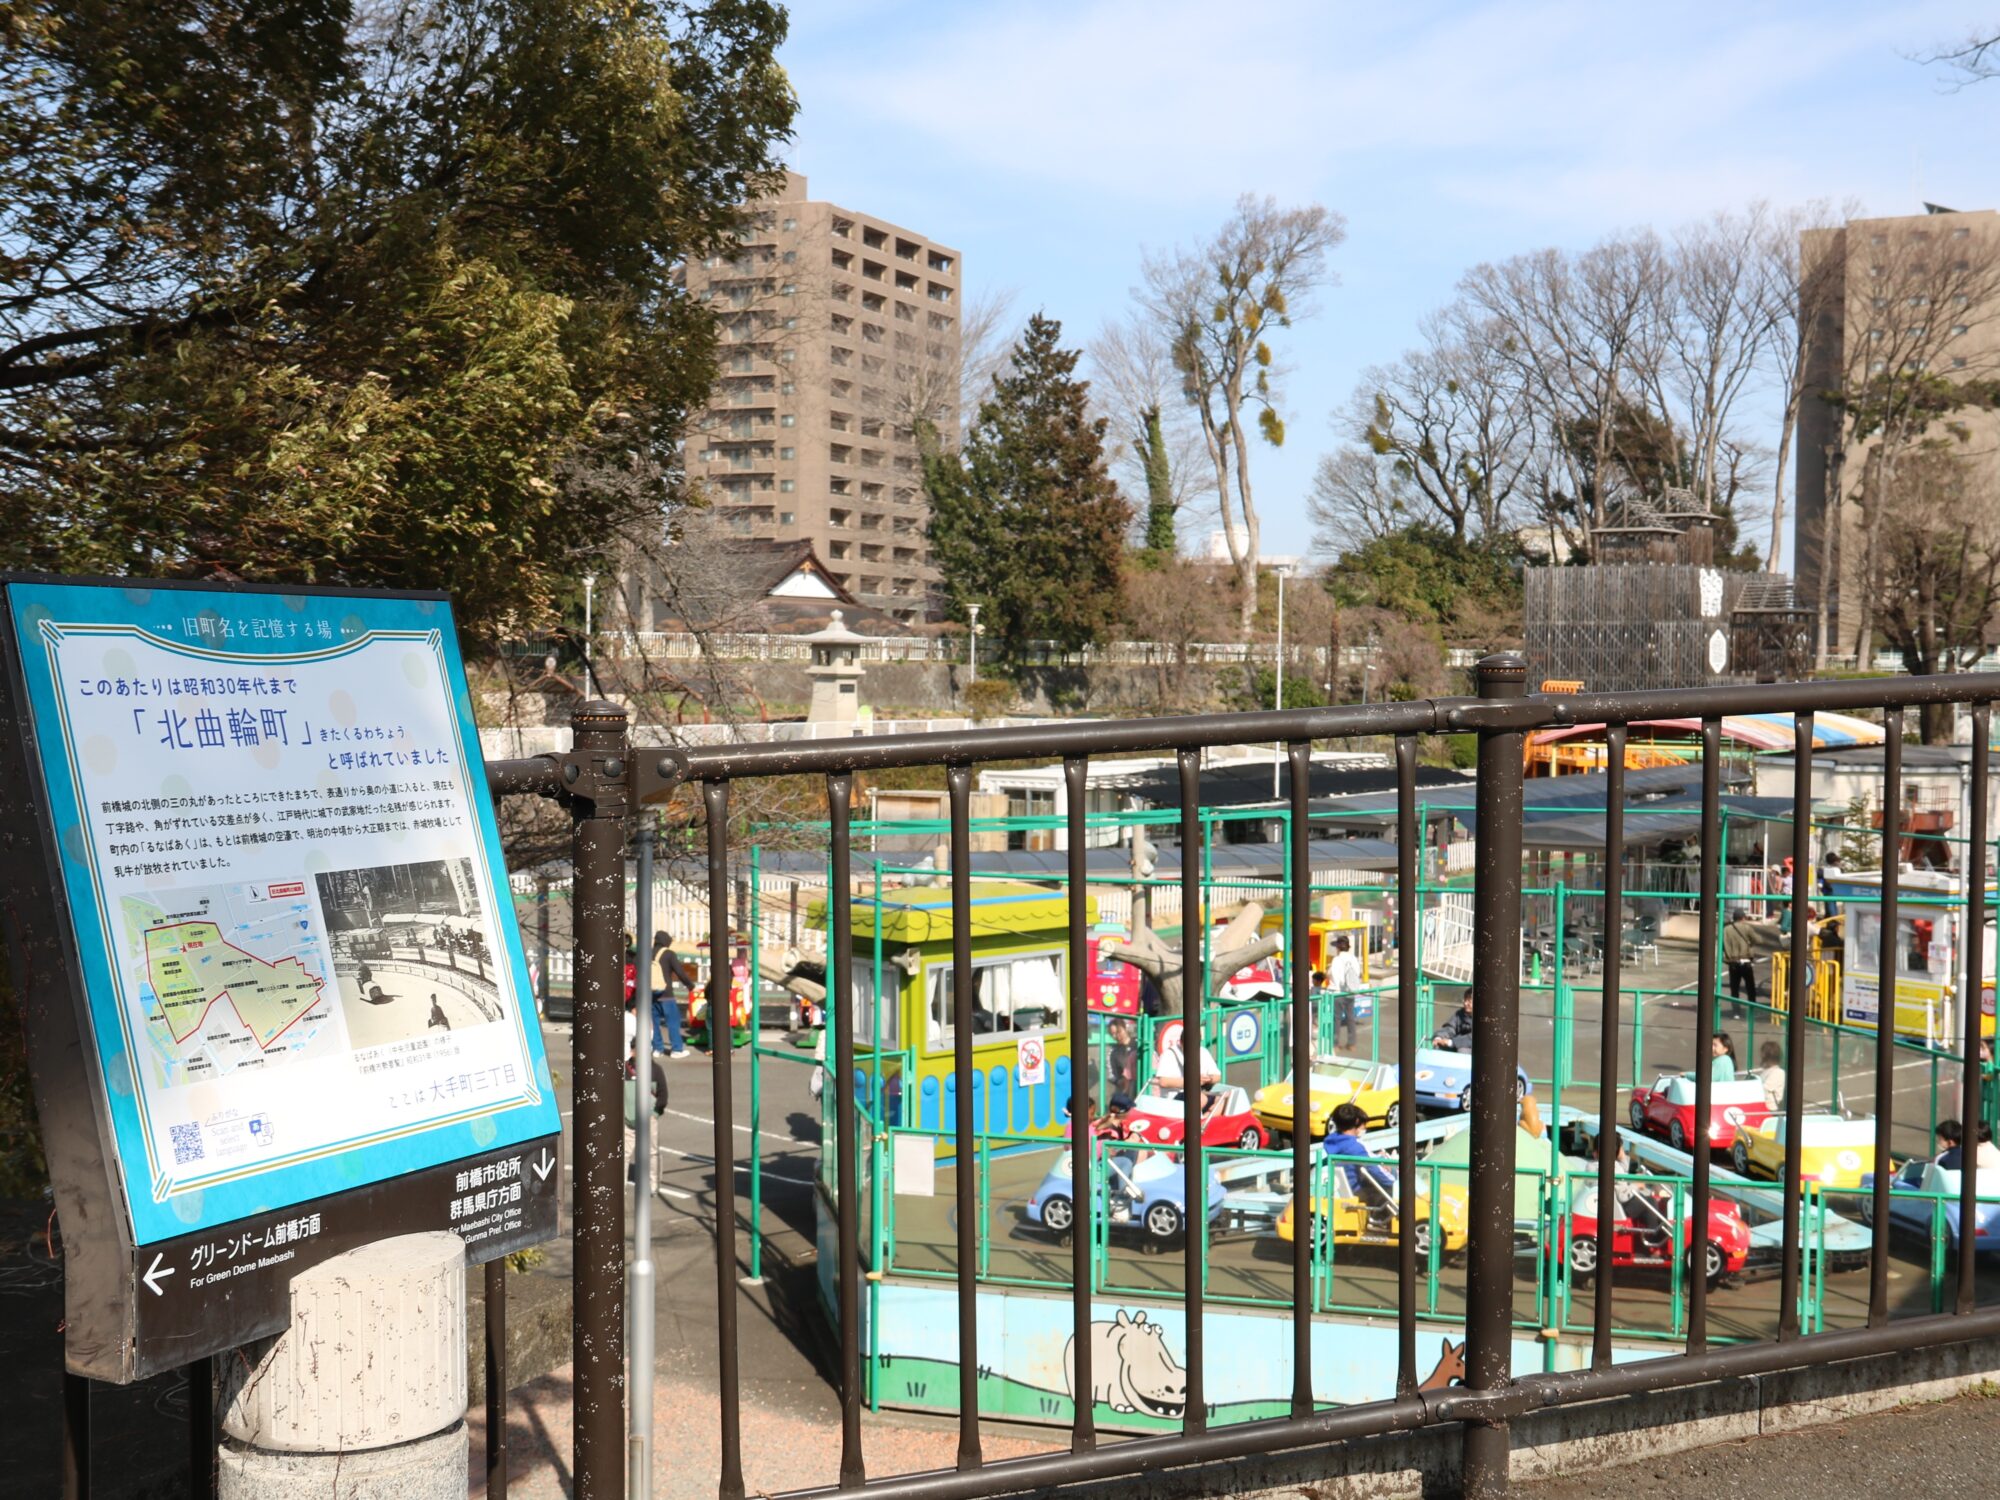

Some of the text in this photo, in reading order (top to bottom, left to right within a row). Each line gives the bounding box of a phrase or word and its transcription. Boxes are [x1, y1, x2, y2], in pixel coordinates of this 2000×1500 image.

[182, 616, 332, 640] 旧町名を記憶する場
[79, 676, 297, 697] このあたりは昭和30年代まで
[320, 725, 406, 742] きたくるわちょう
[328, 748, 449, 770] と呼ばれていました
[114, 856, 231, 878] 乳牛が放牧されていました。
[456, 1155, 522, 1193] 前橋市役所
[450, 1181, 522, 1220] 群馬県庁方面
[460, 1215, 491, 1233] Maebashi
[491, 1212, 503, 1223] City
[504, 1207, 522, 1219] Office
[465, 1219, 522, 1245] Gunma Pref. Office
[190, 1213, 321, 1271] グリーンドーム前橋方面
[190, 1248, 295, 1289] For Green Dome Maebashi
